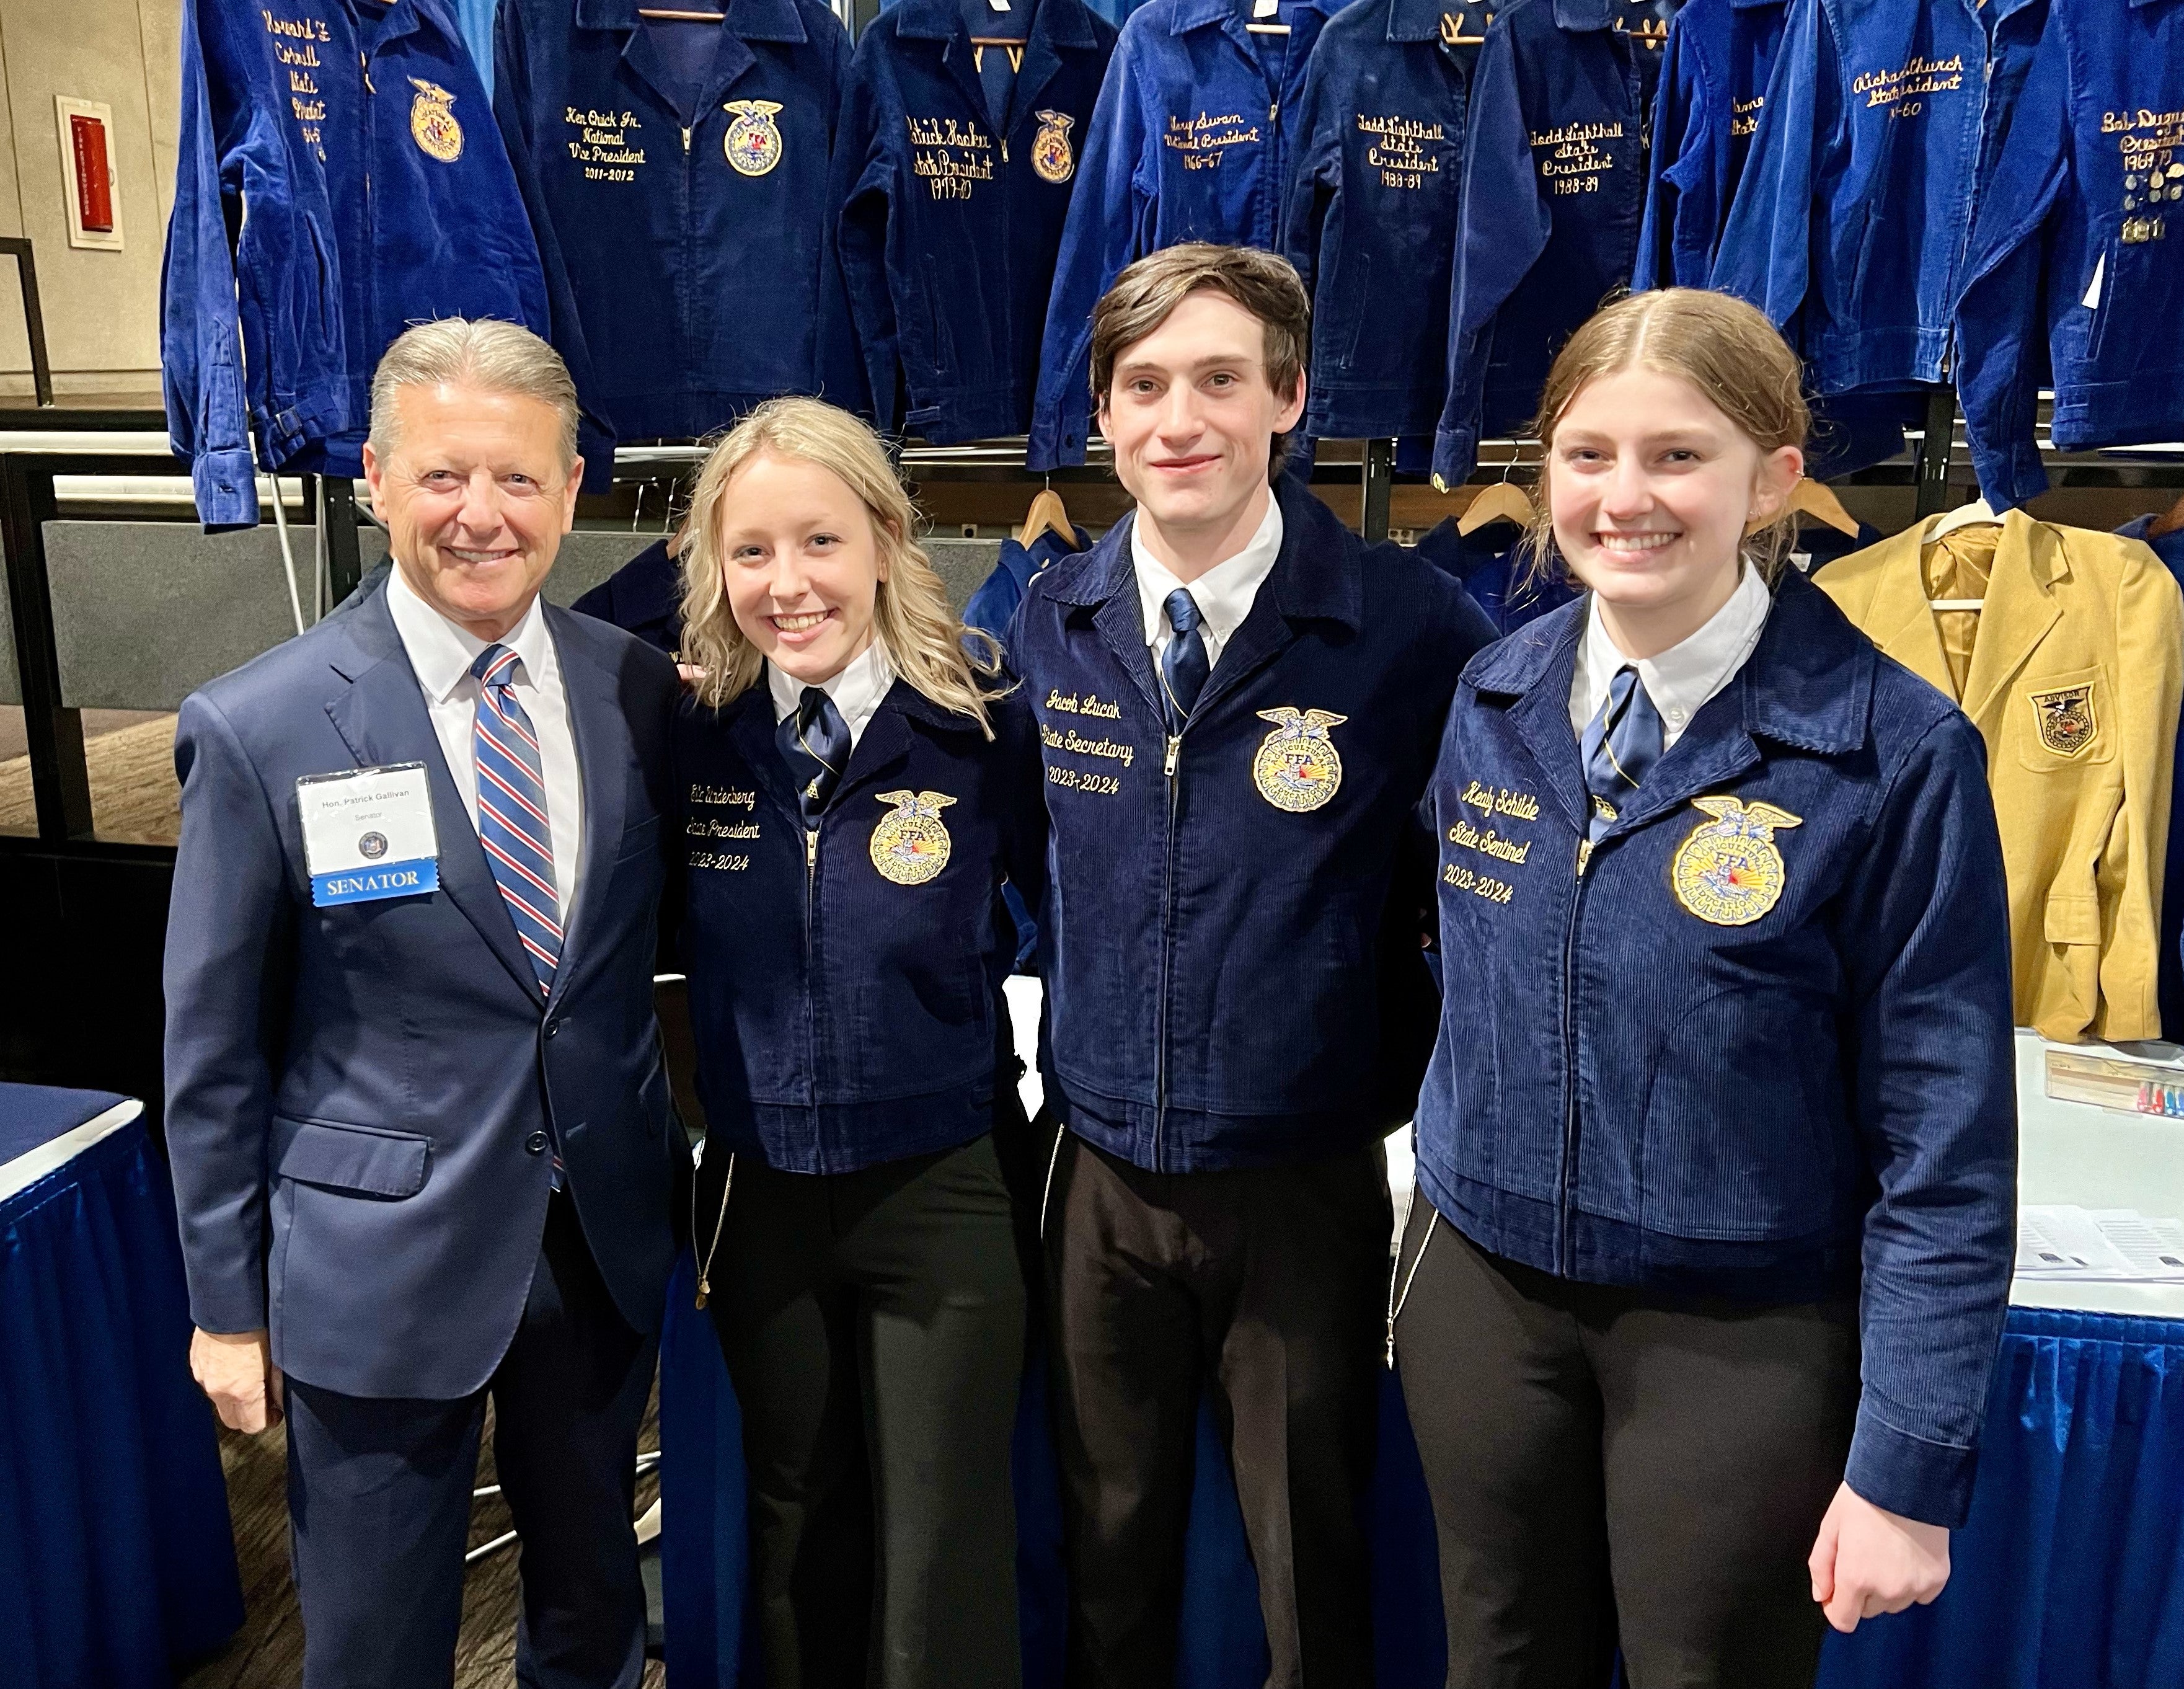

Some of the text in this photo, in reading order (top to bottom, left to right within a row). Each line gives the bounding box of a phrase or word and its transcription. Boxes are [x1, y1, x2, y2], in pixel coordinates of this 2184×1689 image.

[565, 107, 586, 125] Ken
[588, 110, 617, 127] Quick
[1195, 110, 1244, 130] Swan
[583, 128, 625, 145] National
[1201, 127, 1260, 148] President
[1381, 135, 1423, 153] State
[592, 146, 646, 163] President
[1369, 148, 1439, 172] President
[1555, 141, 1599, 159] State
[585, 167, 634, 181] 2011-2012
[938, 149, 993, 180] President
[1542, 153, 1614, 176] President
[931, 177, 971, 200] 1979-80
[1382, 170, 1421, 189] 1988-89
[1555, 176, 1599, 195] 1988-89
[1046, 689, 1078, 713] Jacob
[1064, 729, 1134, 768] Secretary
[1285, 754, 1315, 765] FFA
[1049, 766, 1120, 795] 2023-2024
[322, 790, 410, 809] Hon. Patrick Gallivan
[355, 812, 382, 822] Senator
[707, 818, 761, 839] President
[900, 830, 926, 841] FFA
[1449, 820, 1531, 864] State Sentinel
[1713, 852, 1753, 872] FFA
[327, 871, 420, 896] SENATOR
[1443, 864, 1514, 905] 2023-2024
